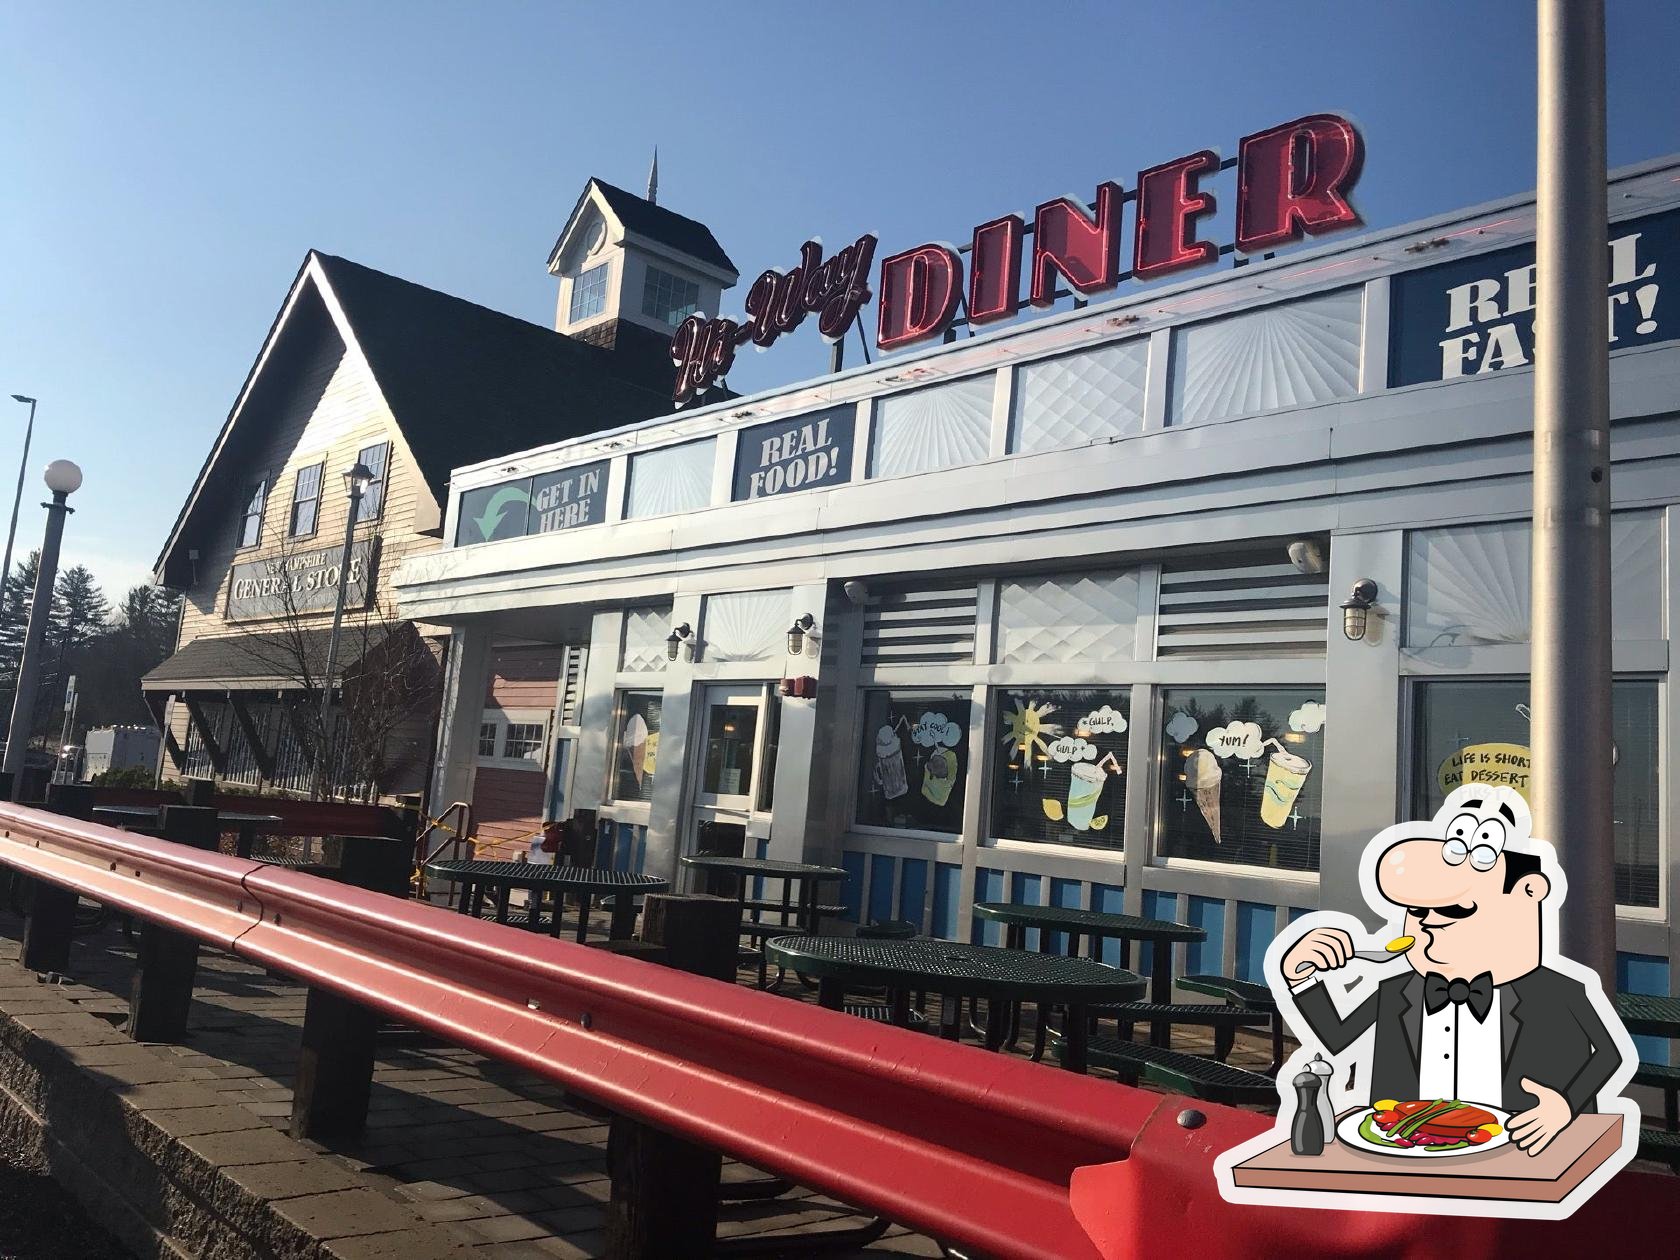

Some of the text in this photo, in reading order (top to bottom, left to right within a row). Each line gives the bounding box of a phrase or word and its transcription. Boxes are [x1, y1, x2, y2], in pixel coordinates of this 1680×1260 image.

[877, 112, 1366, 349] DINER
[1445, 233, 1657, 332] REL
[759, 418, 832, 467] REAL
[536, 469, 601, 512] GET IN
[748, 447, 839, 500] FOOD!
[539, 499, 591, 534] HERE
[283, 552, 327, 572] AMPSHIRE
[306, 557, 362, 592] STOE
[1218, 733, 1250, 748] YUM!
[1452, 752, 1475, 767] LIFE
[1480, 753, 1490, 763] IS
[1444, 769, 1529, 788] EAT DESSERT
